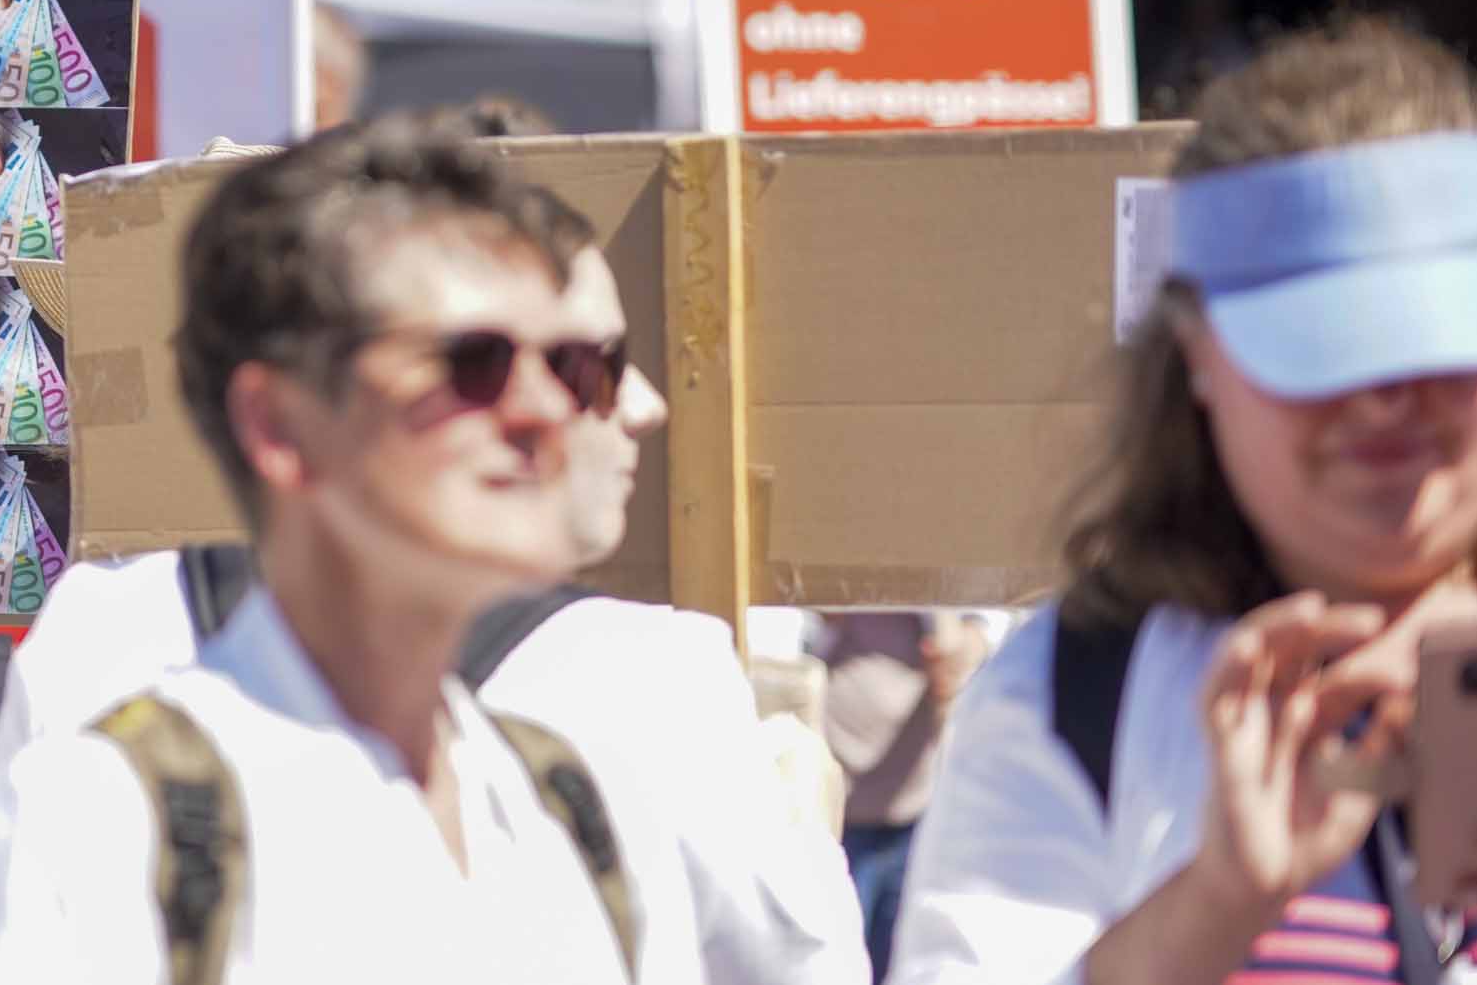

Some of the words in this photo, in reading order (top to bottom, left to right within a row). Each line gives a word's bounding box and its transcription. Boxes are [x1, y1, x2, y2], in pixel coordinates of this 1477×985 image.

[27, 52, 59, 106] 100
[53, 31, 92, 93] 500
[19, 220, 55, 259] 10
[10, 387, 42, 443] 100
[38, 370, 68, 432] 500
[10, 557, 43, 613] 100
